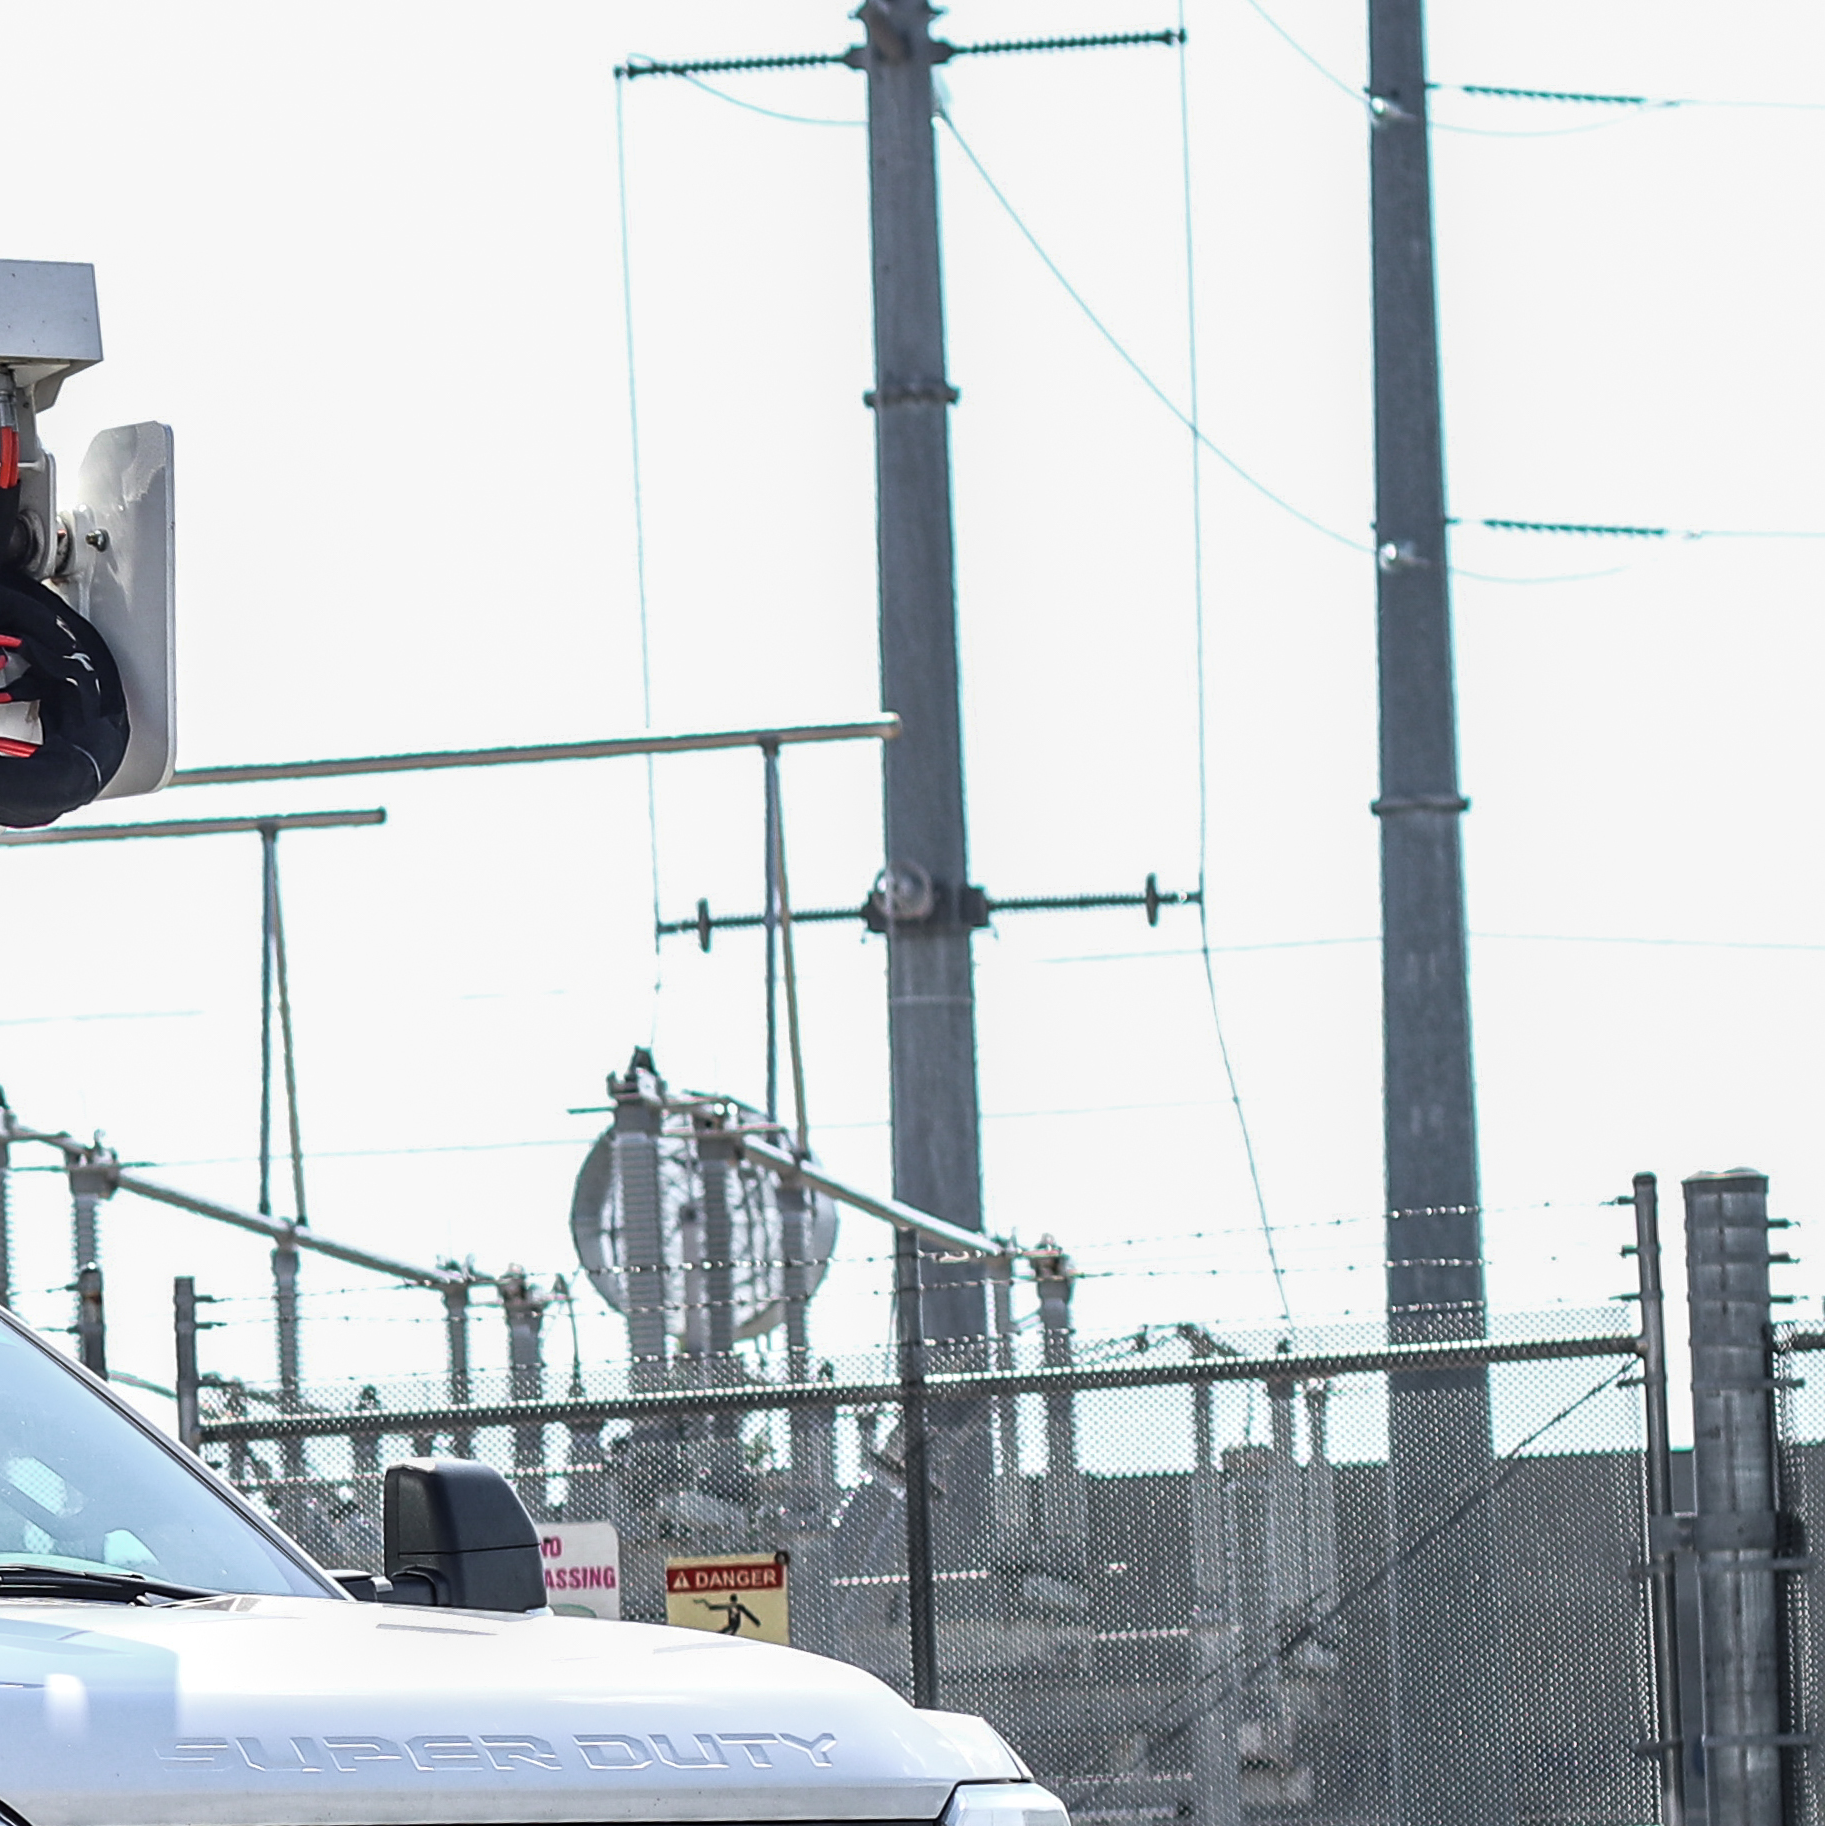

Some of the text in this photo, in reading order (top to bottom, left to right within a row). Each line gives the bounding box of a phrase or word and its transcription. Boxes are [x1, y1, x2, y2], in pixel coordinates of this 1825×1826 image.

[695, 1568, 777, 1590] DANGER
[155, 1733, 838, 1773] SUPER DUTY
